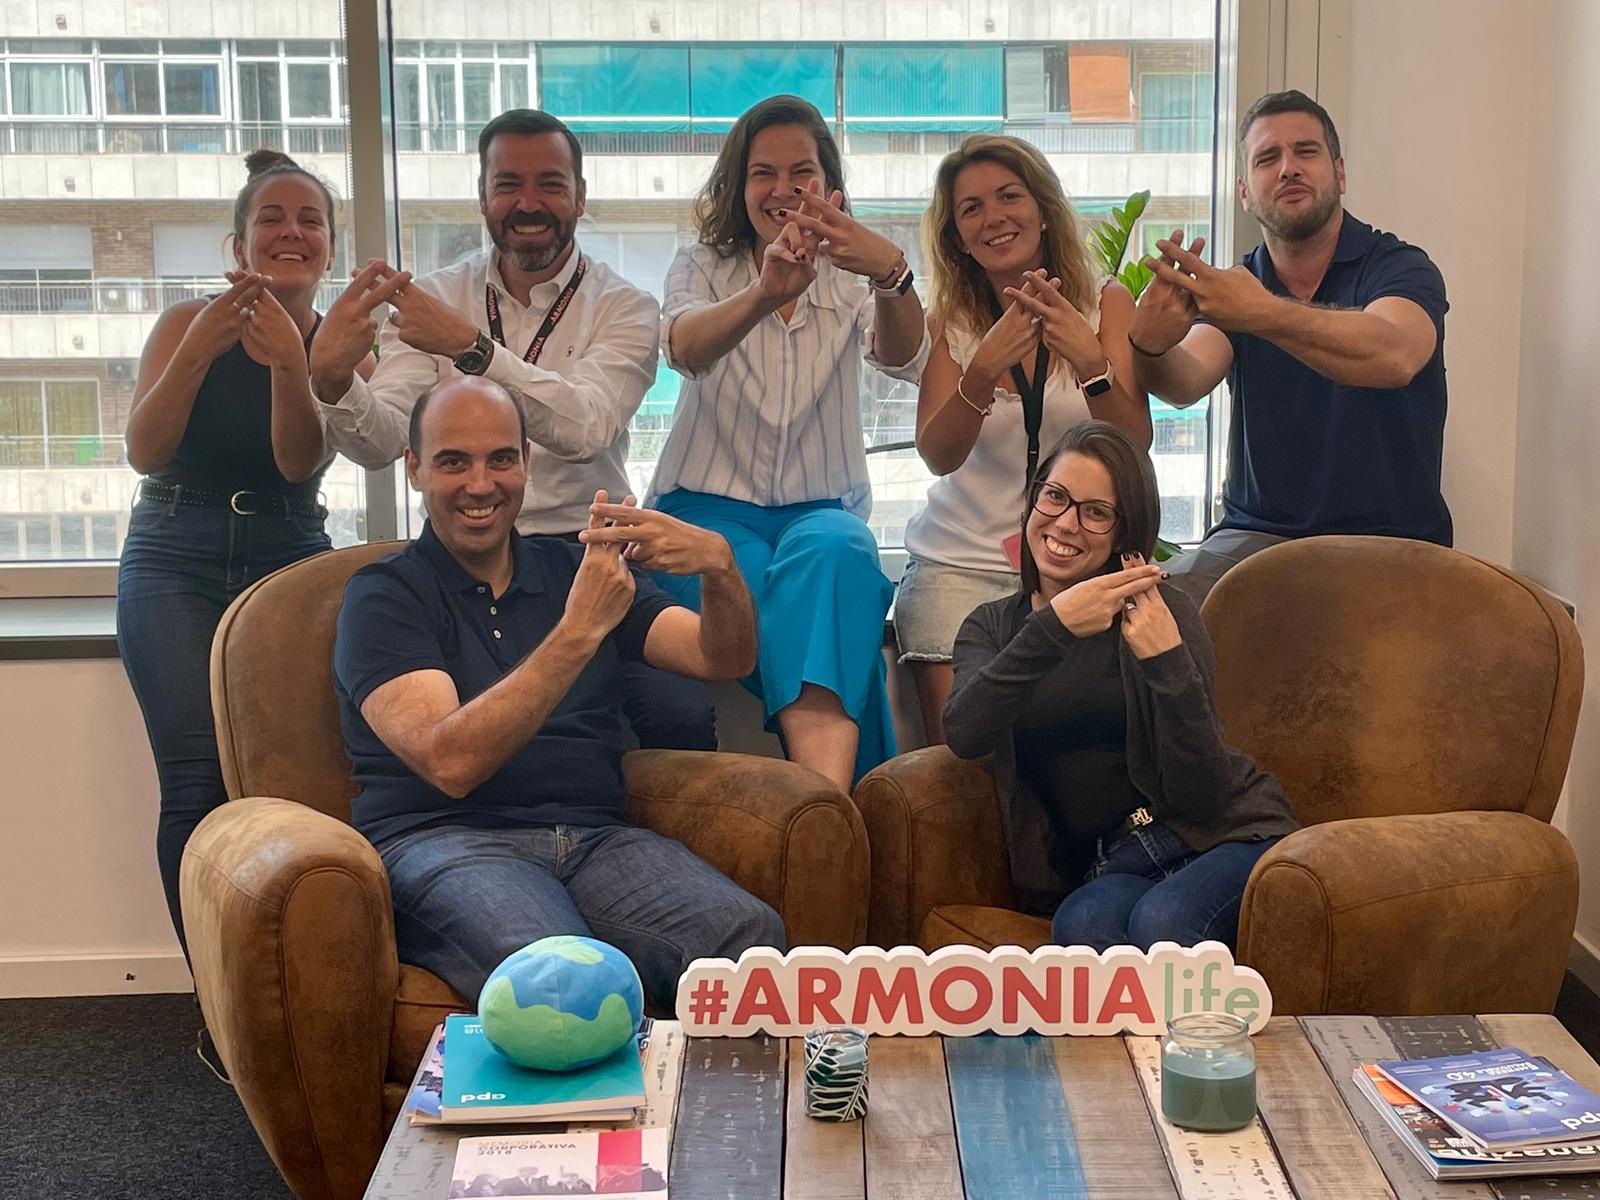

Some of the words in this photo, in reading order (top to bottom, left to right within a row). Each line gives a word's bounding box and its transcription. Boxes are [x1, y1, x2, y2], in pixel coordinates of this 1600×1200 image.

[461, 1092, 506, 1103] apd
[1560, 1111, 1600, 1130] pd
[478, 1143, 576, 1151] CORPORATIVA
